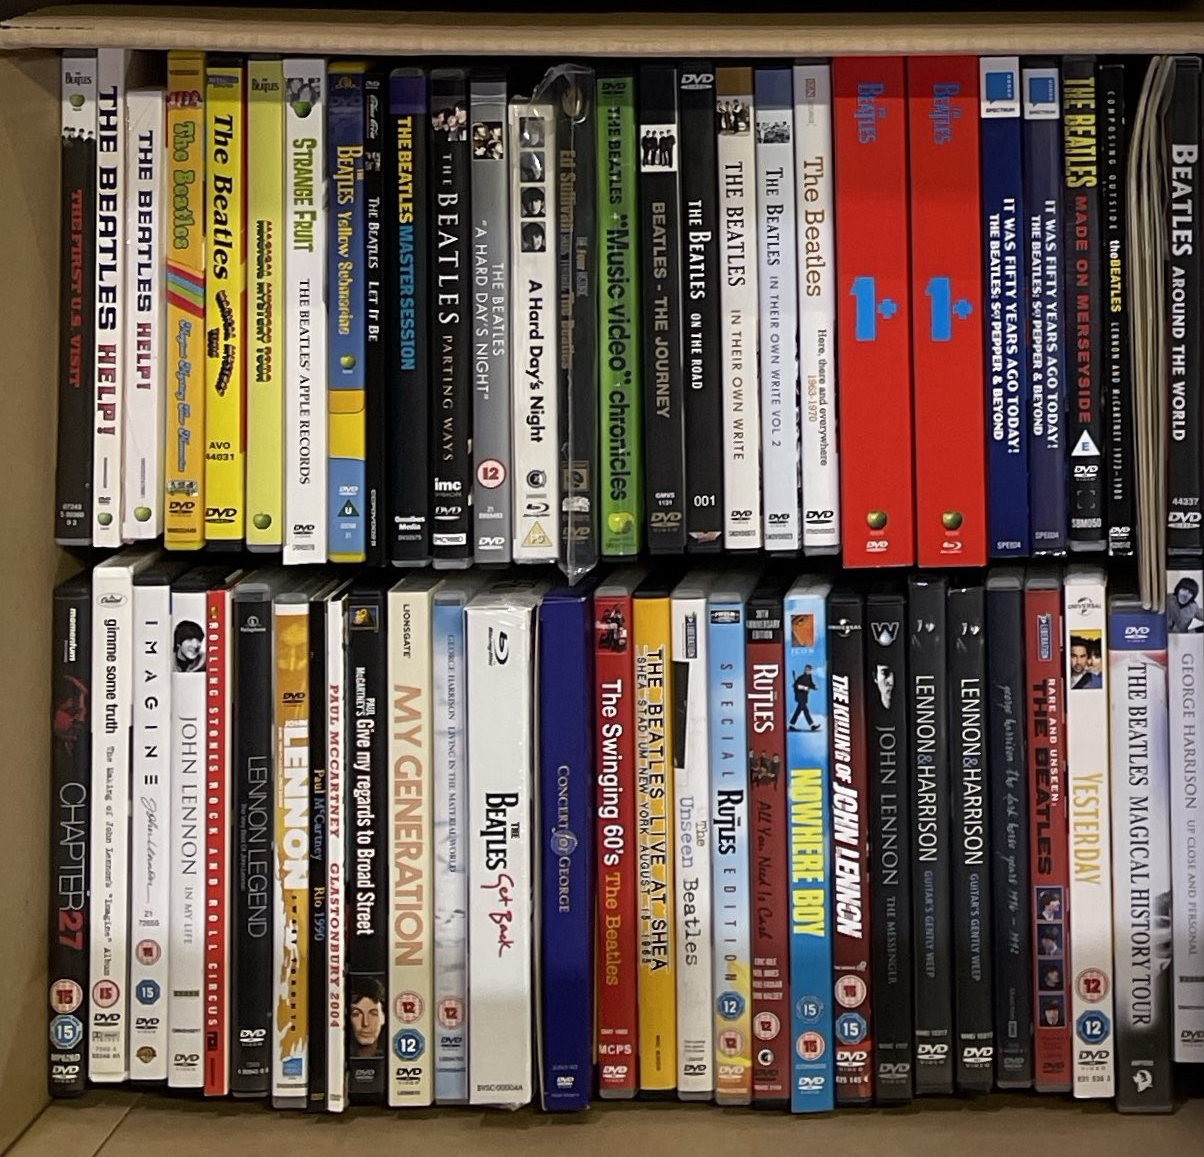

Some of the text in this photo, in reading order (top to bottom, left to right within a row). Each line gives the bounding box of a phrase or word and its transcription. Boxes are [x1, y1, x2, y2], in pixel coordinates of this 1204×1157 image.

[97, 86, 118, 435] THE BEATLES HELP!
[213, 115, 233, 280] The Beatles
[292, 138, 317, 253] STRANGE FRUIT
[526, 279, 545, 443] A Hard Day's Night
[725, 162, 745, 460] THE BEATLES IN THEIR OWN WRITE
[1172, 144, 1198, 441] BEATLES AROUND THE WORLD
[206, 453, 234, 461] 44031
[299, 375, 310, 484] APPLE RECORDS
[442, 336, 454, 461] PARTING WAYS
[694, 495, 716, 506] 001
[104, 619, 118, 734] gimme some truth
[748, 664, 778, 733] RUTLES
[356, 849, 374, 935] Broad Street
[394, 685, 423, 966] MY GENERATION
[598, 679, 624, 985] The Swinging 60's The Beatles
[791, 769, 824, 937] NOWHERE BOY
[1072, 774, 1102, 884] YESTERDAY
[1128, 663, 1151, 1025] THE BEATLES MAGICAL HISTORY TOUR
[329, 863, 339, 1027] GLASTONBURY 2004
